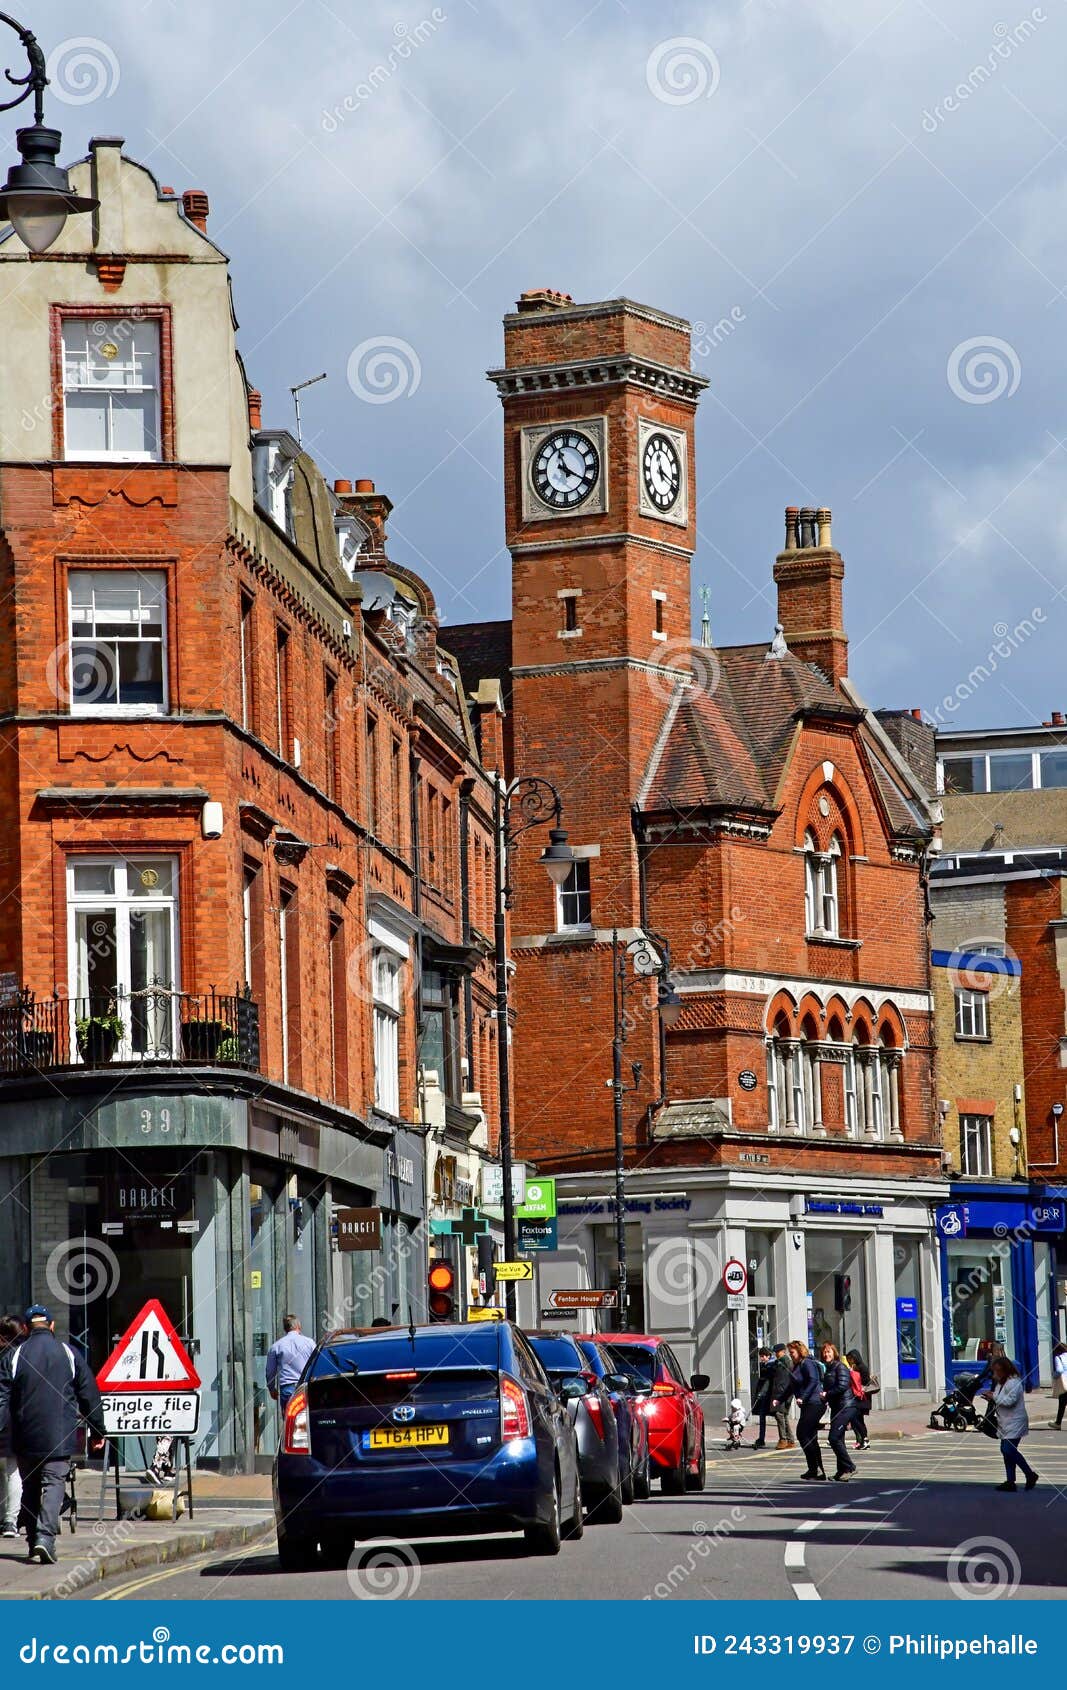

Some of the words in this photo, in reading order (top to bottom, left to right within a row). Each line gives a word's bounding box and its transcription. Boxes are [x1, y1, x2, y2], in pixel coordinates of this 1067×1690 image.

[140, 1108, 170, 1133] 39
[524, 1203, 547, 1212] OXFAM
[556, 1201, 604, 1215] ationwide
[654, 1197, 691, 1212] Society
[521, 1226, 553, 1234] Foxtons
[558, 1295, 579, 1303] Fenton
[580, 1295, 600, 1303] House
[102, 1398, 153, 1416] Single
[164, 1397, 192, 1412] file
[116, 1416, 172, 1430] traffic
[373, 1428, 412, 1445] LT64
[416, 1425, 445, 1442] HPV
